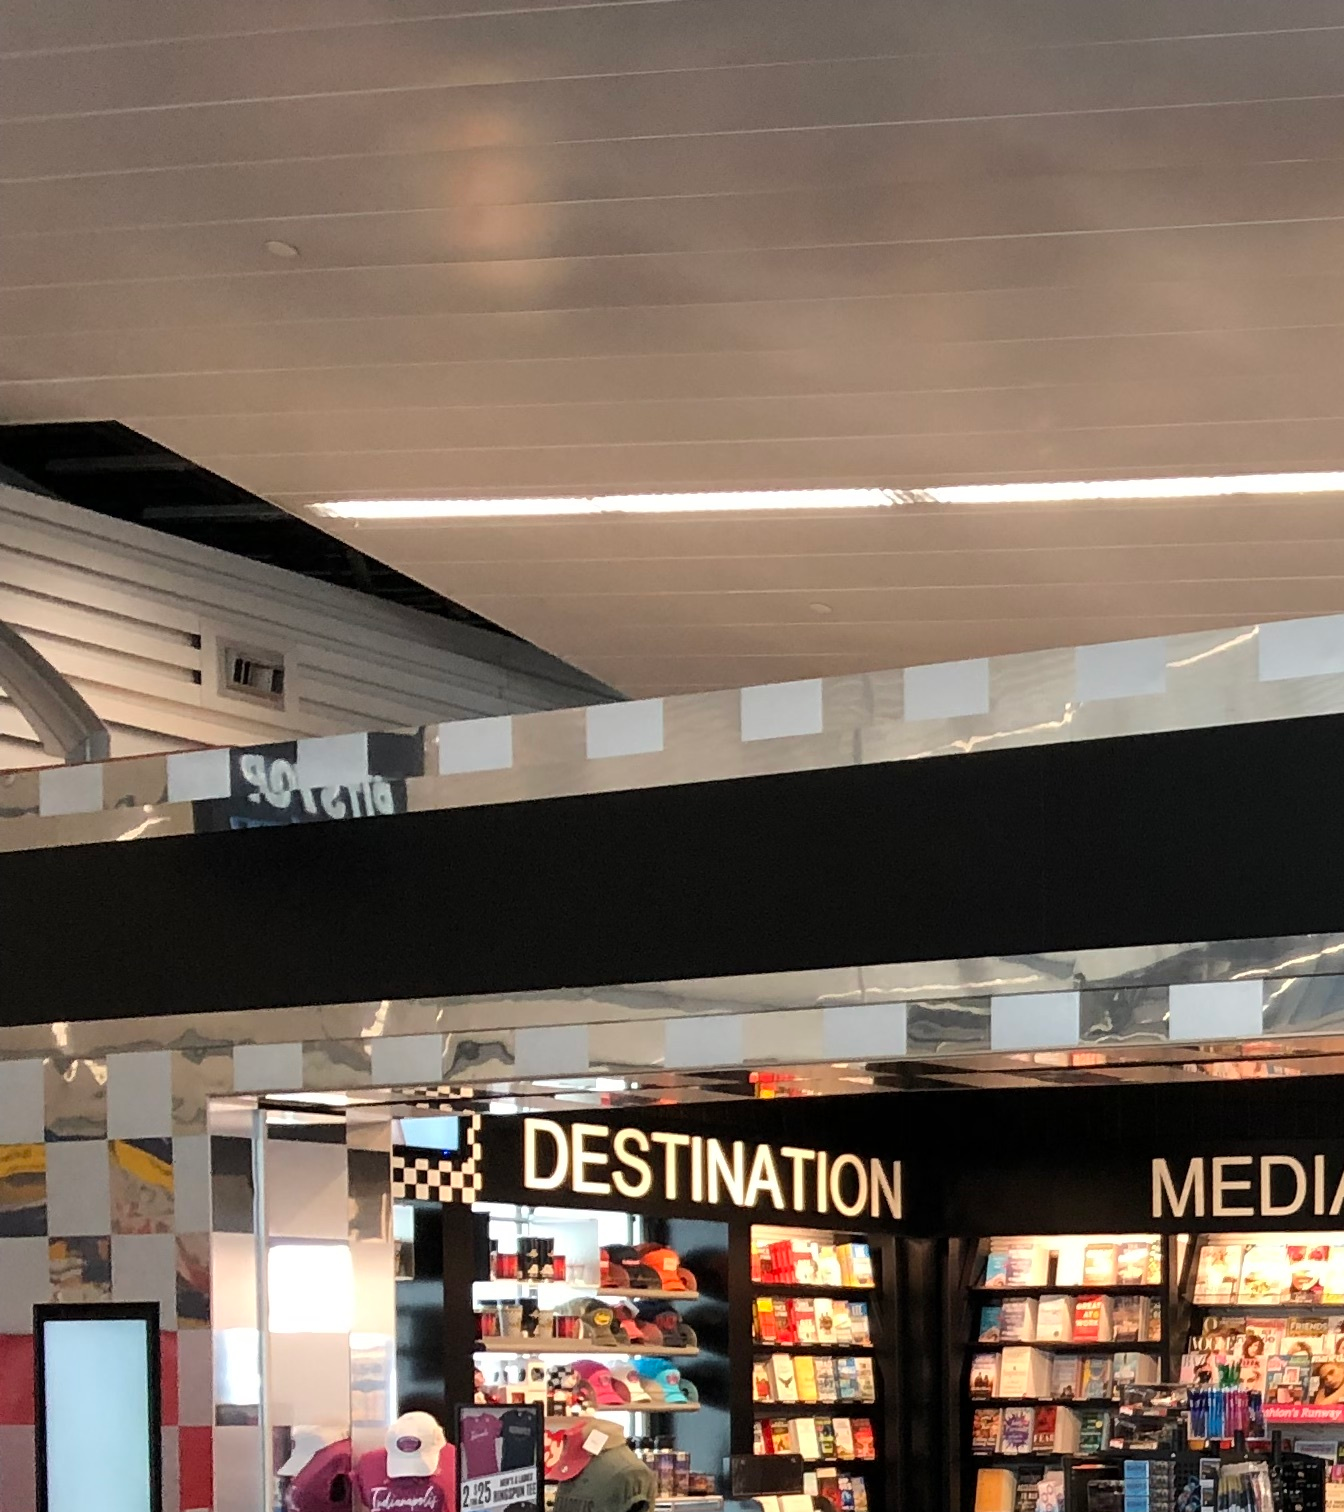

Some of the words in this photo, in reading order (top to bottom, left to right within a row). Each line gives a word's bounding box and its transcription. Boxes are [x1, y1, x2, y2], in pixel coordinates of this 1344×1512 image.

[524, 1117, 902, 1219] DESTINATION
[1302, 1409, 1342, 1420] Runway
[463, 1485, 469, 1508] 2
